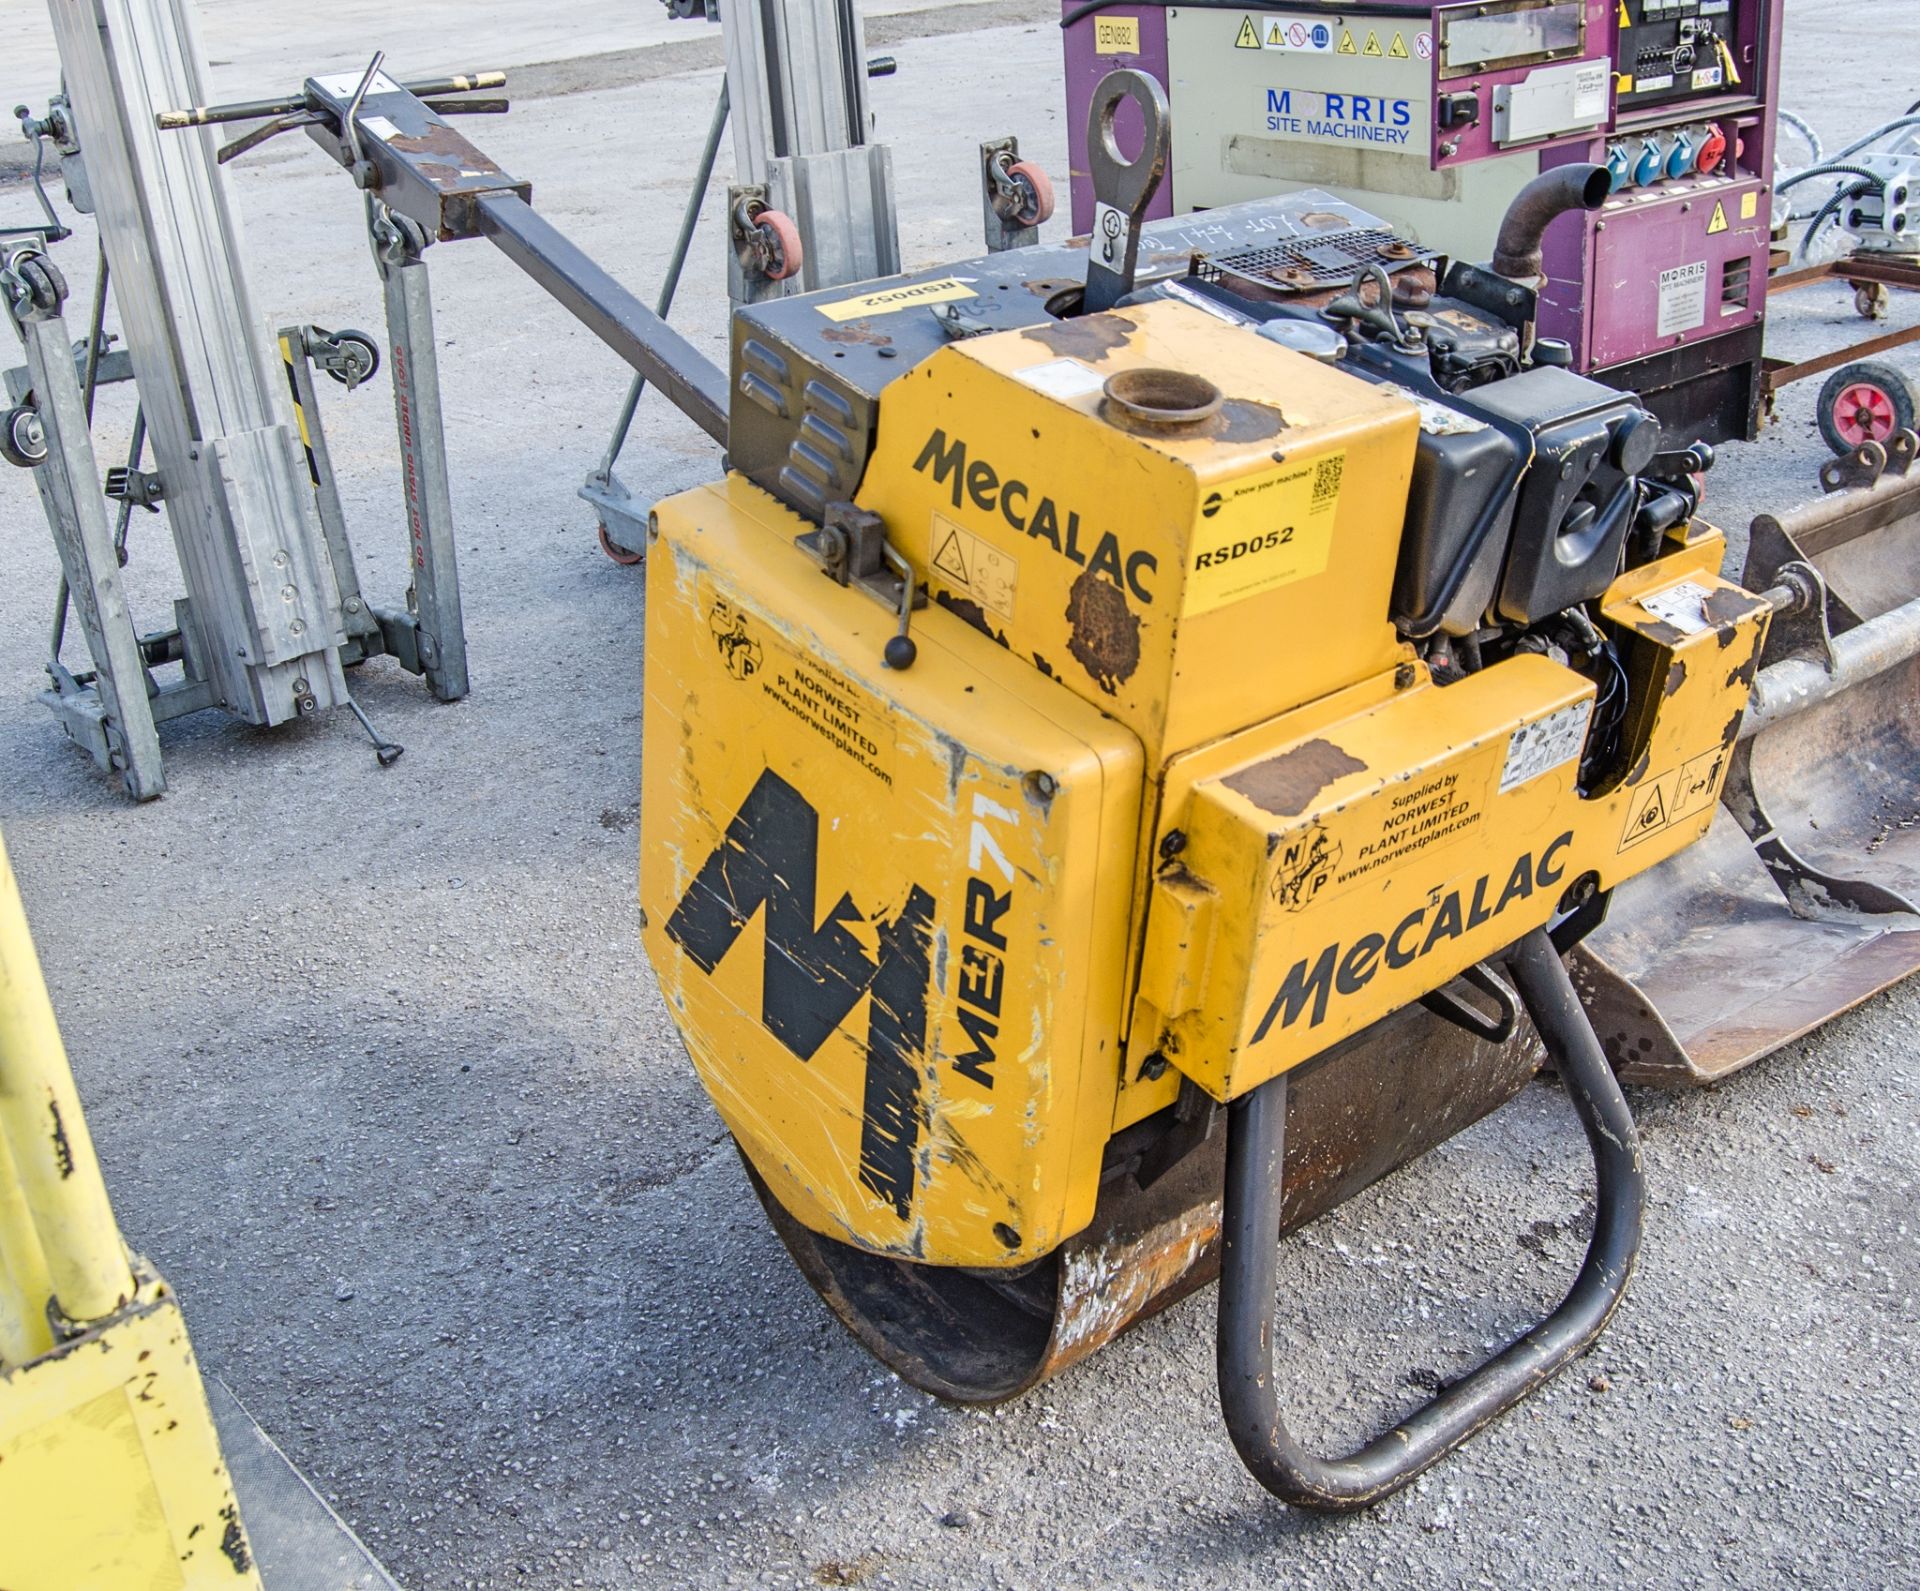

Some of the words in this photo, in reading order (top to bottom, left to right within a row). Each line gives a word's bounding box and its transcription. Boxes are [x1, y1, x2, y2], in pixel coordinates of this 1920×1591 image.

[1098, 25, 1132, 45] GEN882
[1267, 89, 1410, 125] MRRIS
[1267, 116, 1301, 133] SITE
[1307, 120, 1410, 144] MACHINERY
[1661, 263, 1705, 283] MORRIS
[861, 281, 957, 306] RSD052
[400, 395, 412, 448] UNDER
[406, 453, 418, 504] STAND
[1233, 487, 1256, 497] Know
[1257, 480, 1275, 493] your
[1276, 467, 1313, 484] machine?
[412, 509, 422, 541] NOT
[416, 545, 425, 569] DO
[1195, 526, 1294, 571] RSD052
[794, 668, 861, 724] NORWEST
[762, 682, 892, 786] www.norwestplant.com
[777, 675, 820, 713] PLANT
[823, 708, 878, 757] LIMITED
[1382, 790, 1457, 832] NORWEST
[1391, 777, 1445, 810] Supplied
[1444, 774, 1459, 787] by
[1337, 812, 1480, 884] www.norwestplant.com
[1358, 829, 1409, 859] PLANT
[1411, 801, 1470, 836] LIMITED
